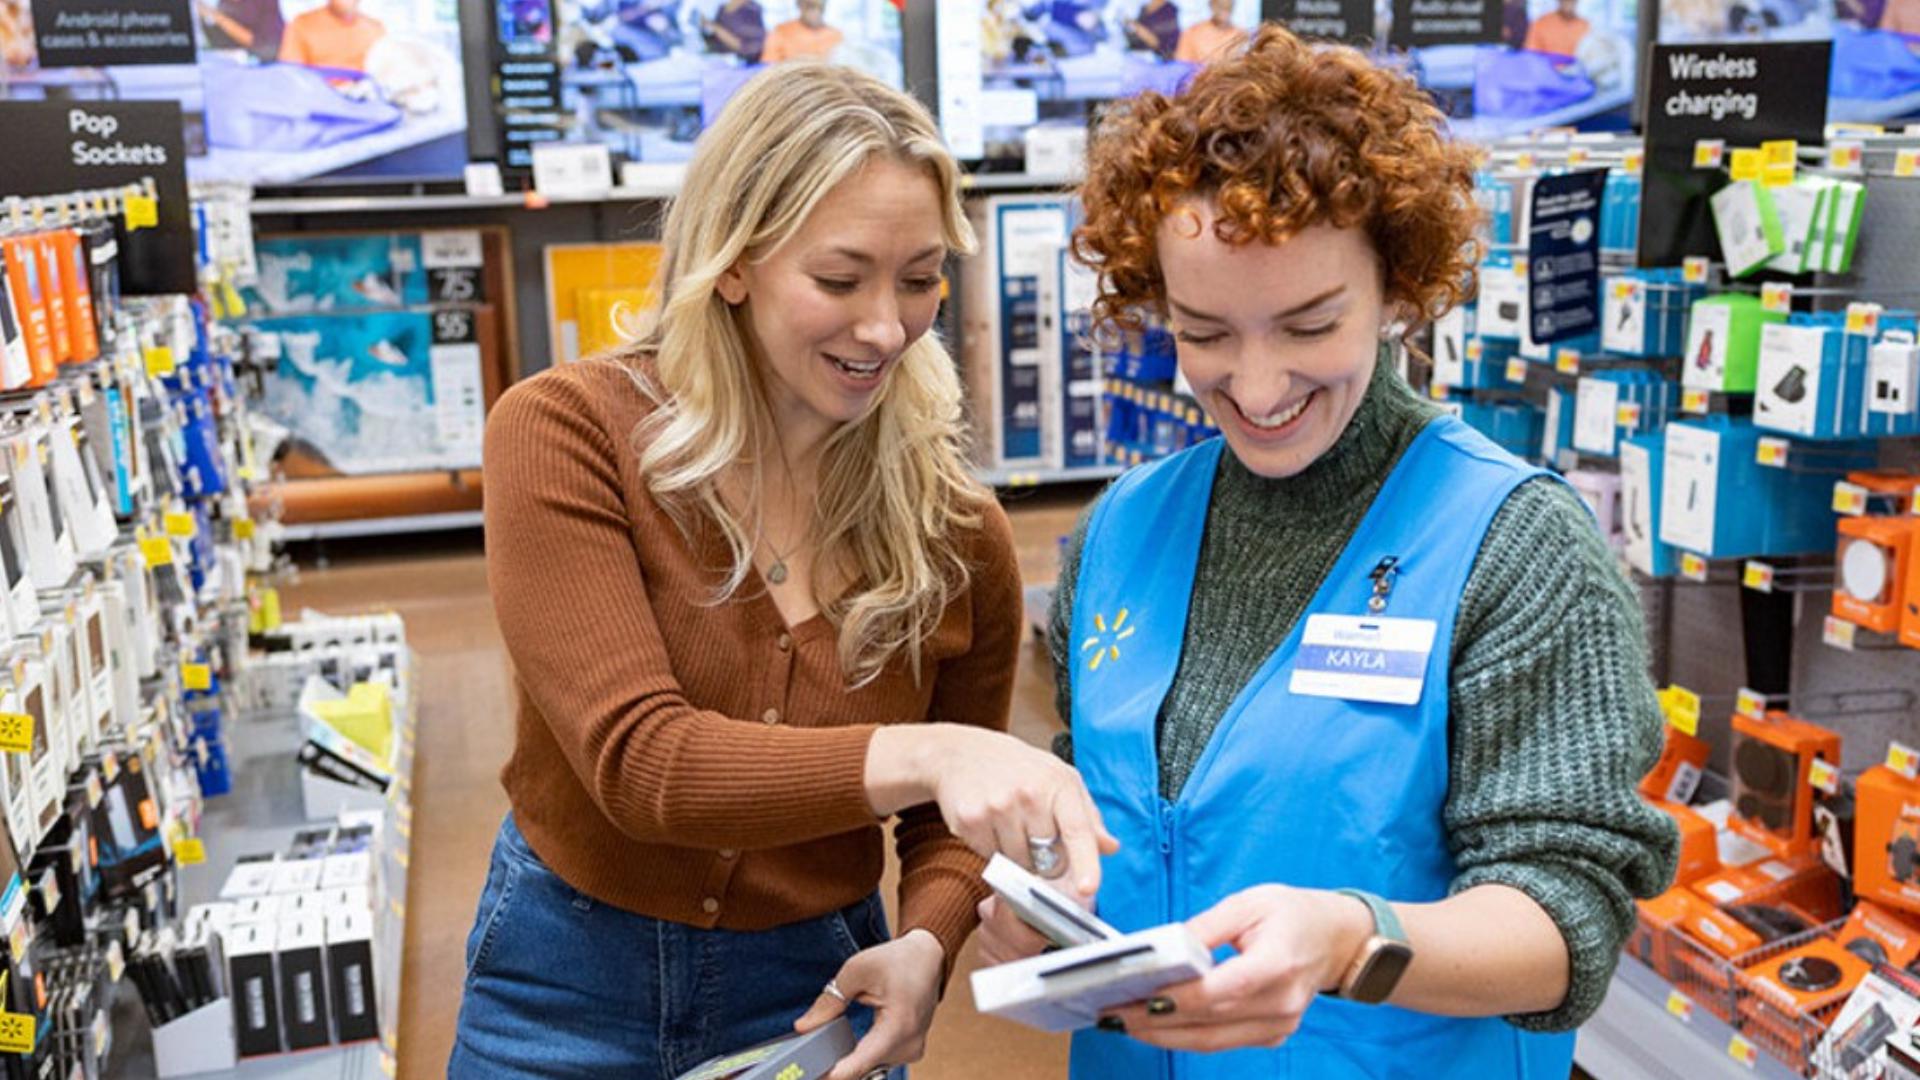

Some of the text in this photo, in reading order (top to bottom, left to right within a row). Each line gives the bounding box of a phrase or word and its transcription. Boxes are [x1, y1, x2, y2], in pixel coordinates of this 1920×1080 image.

[55, 11, 171, 30] Android phone
[41, 31, 191, 48] cases & accessories
[1669, 52, 1758, 80] Wireless
[1665, 88, 1758, 121] charging
[68, 109, 119, 139] Pop
[71, 140, 167, 166] Sockets
[1325, 649, 1387, 670] KAYLA
